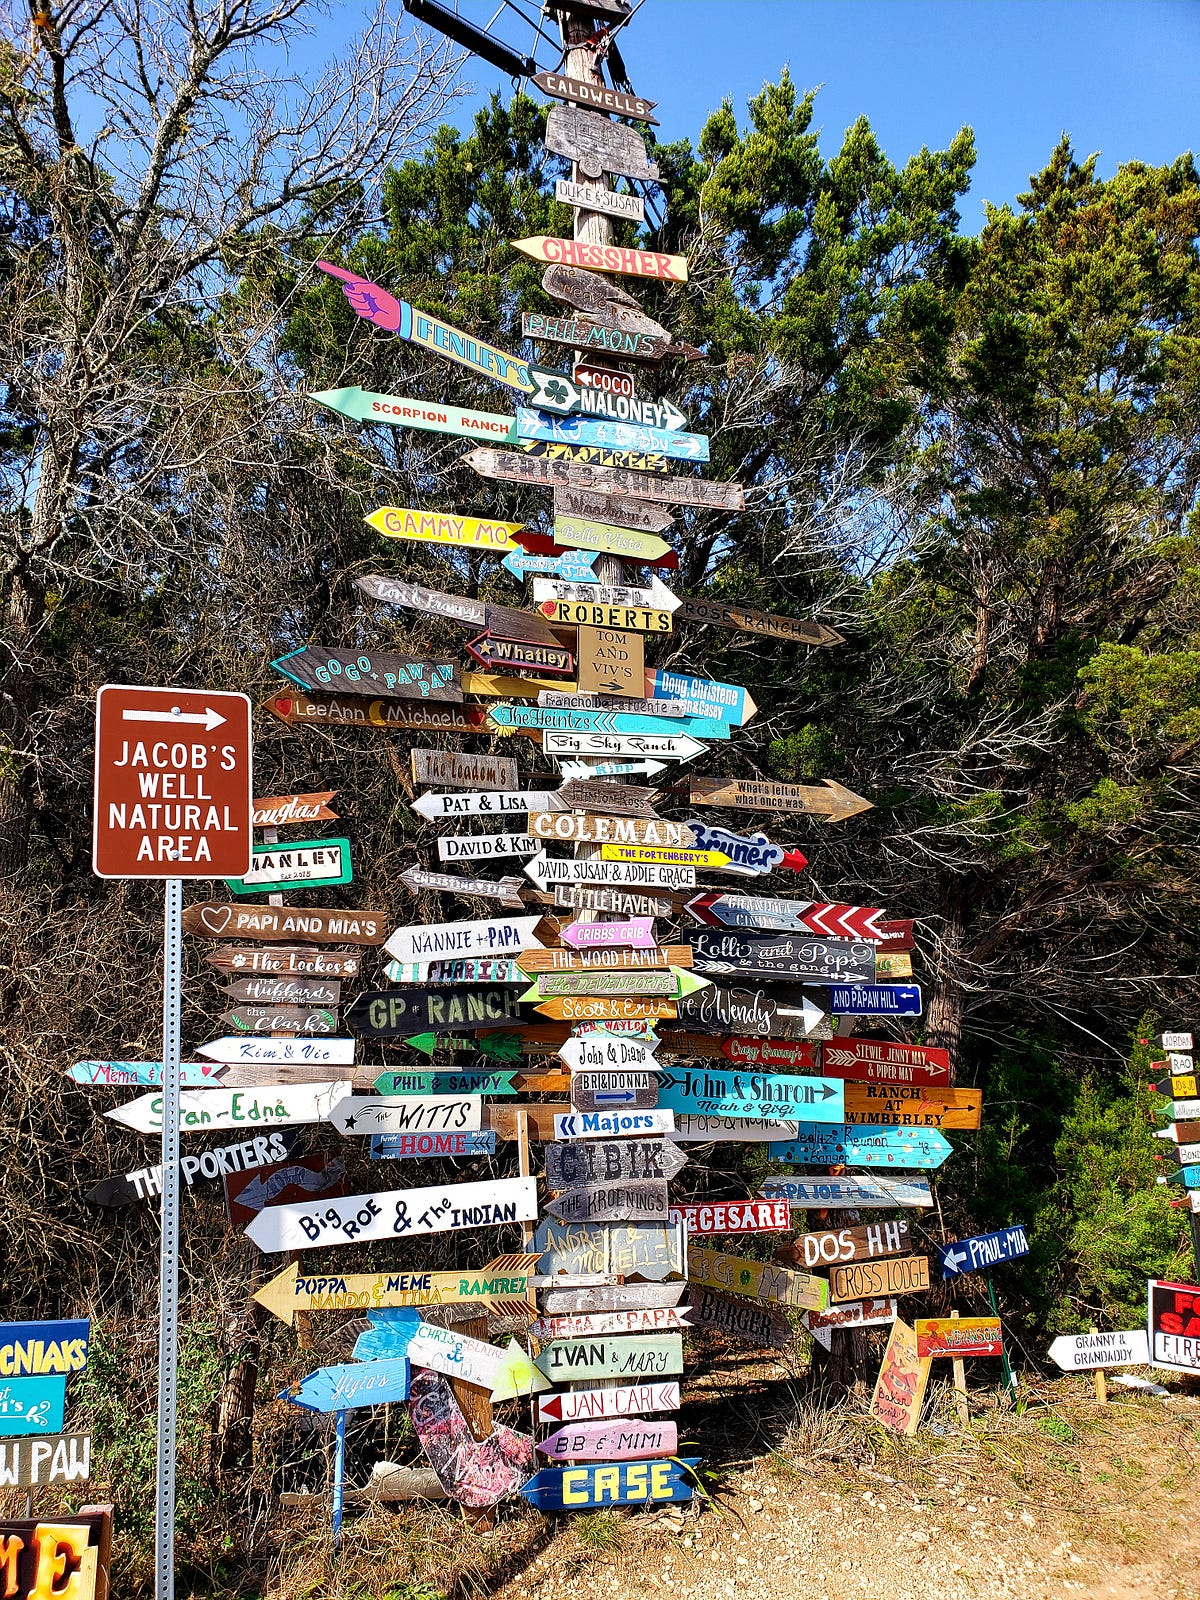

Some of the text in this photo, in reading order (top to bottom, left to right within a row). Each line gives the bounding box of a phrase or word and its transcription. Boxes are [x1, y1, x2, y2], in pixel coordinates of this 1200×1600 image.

[547, 76, 645, 115] CALDWELLS
[559, 182, 641, 213] DUKE SUSAN
[542, 238, 680, 280] CHESSHER
[417, 316, 531, 386] FENLEY'S
[592, 373, 631, 395] COCO
[372, 402, 509, 434] SCORPION RANCH
[581, 388, 664, 429] MALONEY
[385, 512, 508, 545] GAMMY MO
[561, 525, 643, 551] Bella Vista
[562, 564, 596, 578] JIM
[558, 603, 671, 630] ROBERTS
[685, 599, 802, 635] ROSE RANCH
[596, 630, 627, 645] TOM
[496, 642, 566, 668] Whatley
[596, 648, 629, 661] AND
[384, 663, 454, 697] PAW PAW
[591, 662, 632, 679] VIV'S
[661, 673, 738, 706] Doug, Christene
[387, 705, 466, 728] Michaela
[113, 740, 236, 770] JACOB'S
[550, 734, 677, 752] Big Sky Ranch
[426, 755, 506, 785] The Leadem's
[138, 773, 212, 800] WELL
[737, 781, 801, 797] What's left of
[252, 796, 327, 826] ouglas'
[479, 794, 492, 811] &
[735, 793, 784, 807] what once
[109, 803, 239, 831] NATURAL
[534, 814, 683, 846] COLEMAN
[136, 835, 212, 862] AREA
[495, 838, 507, 852] &
[618, 848, 708, 863] THE FORTENBERRY'S
[538, 861, 693, 886] DAVID, SUSAN ADDIE GRACE
[557, 886, 659, 915] LITTLE HAVEN
[237, 914, 377, 936] PAPI AND MIA'S
[577, 926, 645, 941] CRIBBS' CRIB
[412, 925, 521, 954] NANNIE PAPA
[249, 952, 344, 975] The Lockes
[551, 948, 670, 968] THE WOOD FAMILY
[690, 934, 873, 971] Lolli and Pops
[758, 960, 829, 974] the gang
[244, 982, 336, 1001] Hubbards
[833, 990, 899, 1008] AND PAPAW HILL
[247, 1008, 266, 1017] the
[369, 989, 521, 1030] GP RANCH
[562, 998, 674, 1018] Scott Erin
[717, 986, 777, 1034] Wendy
[254, 1015, 330, 1031] Clarks
[240, 1044, 330, 1060] Kim Vic
[579, 1042, 604, 1066] John
[621, 1043, 646, 1063] Diane
[887, 1047, 927, 1065] JENNY MAY
[91, 1066, 138, 1083] Mema
[393, 1076, 502, 1091] PHIL SANDY
[583, 1075, 597, 1089] BR
[876, 1064, 914, 1082] PIPER MAY
[680, 1073, 815, 1104] John Sharon
[866, 1087, 921, 1099] RANCH
[399, 1101, 472, 1130] WITTS
[698, 1101, 740, 1112] Noah
[883, 1099, 903, 1112] AT
[582, 1113, 654, 1134] Majors
[846, 1113, 945, 1127] WIMBERLEY
[400, 1134, 467, 1155] HOME
[181, 1132, 288, 1186] PORTERS
[560, 1188, 665, 1217] THE KROENINGS
[764, 1183, 808, 1200] PAPA
[812, 1184, 843, 1200] JOE
[299, 1200, 517, 1242] Big & INDIAN
[342, 1199, 383, 1239] ROE
[418, 1197, 452, 1230] The
[668, 1203, 787, 1232] DECESARE
[804, 1230, 856, 1267] DOS
[969, 1229, 1030, 1268] PPAUL MIA
[459, 1276, 527, 1297] RAMIREZ
[835, 1259, 929, 1299] CROSS LODGE
[310, 1289, 442, 1308] NANDO TINA
[626, 1308, 682, 1330] PAPA
[701, 1290, 773, 1344] BERGER
[418, 1325, 455, 1345] CHRIS
[1076, 1333, 1116, 1349] GRANNY
[551, 1343, 669, 1372] IVAN MARY
[1074, 1349, 1133, 1365] GRANDADDY
[566, 1386, 661, 1418] JAN CARL
[555, 1432, 663, 1454] BB MIMI
[31, 1435, 91, 1484] PAW
[562, 1462, 674, 1505] CASE
